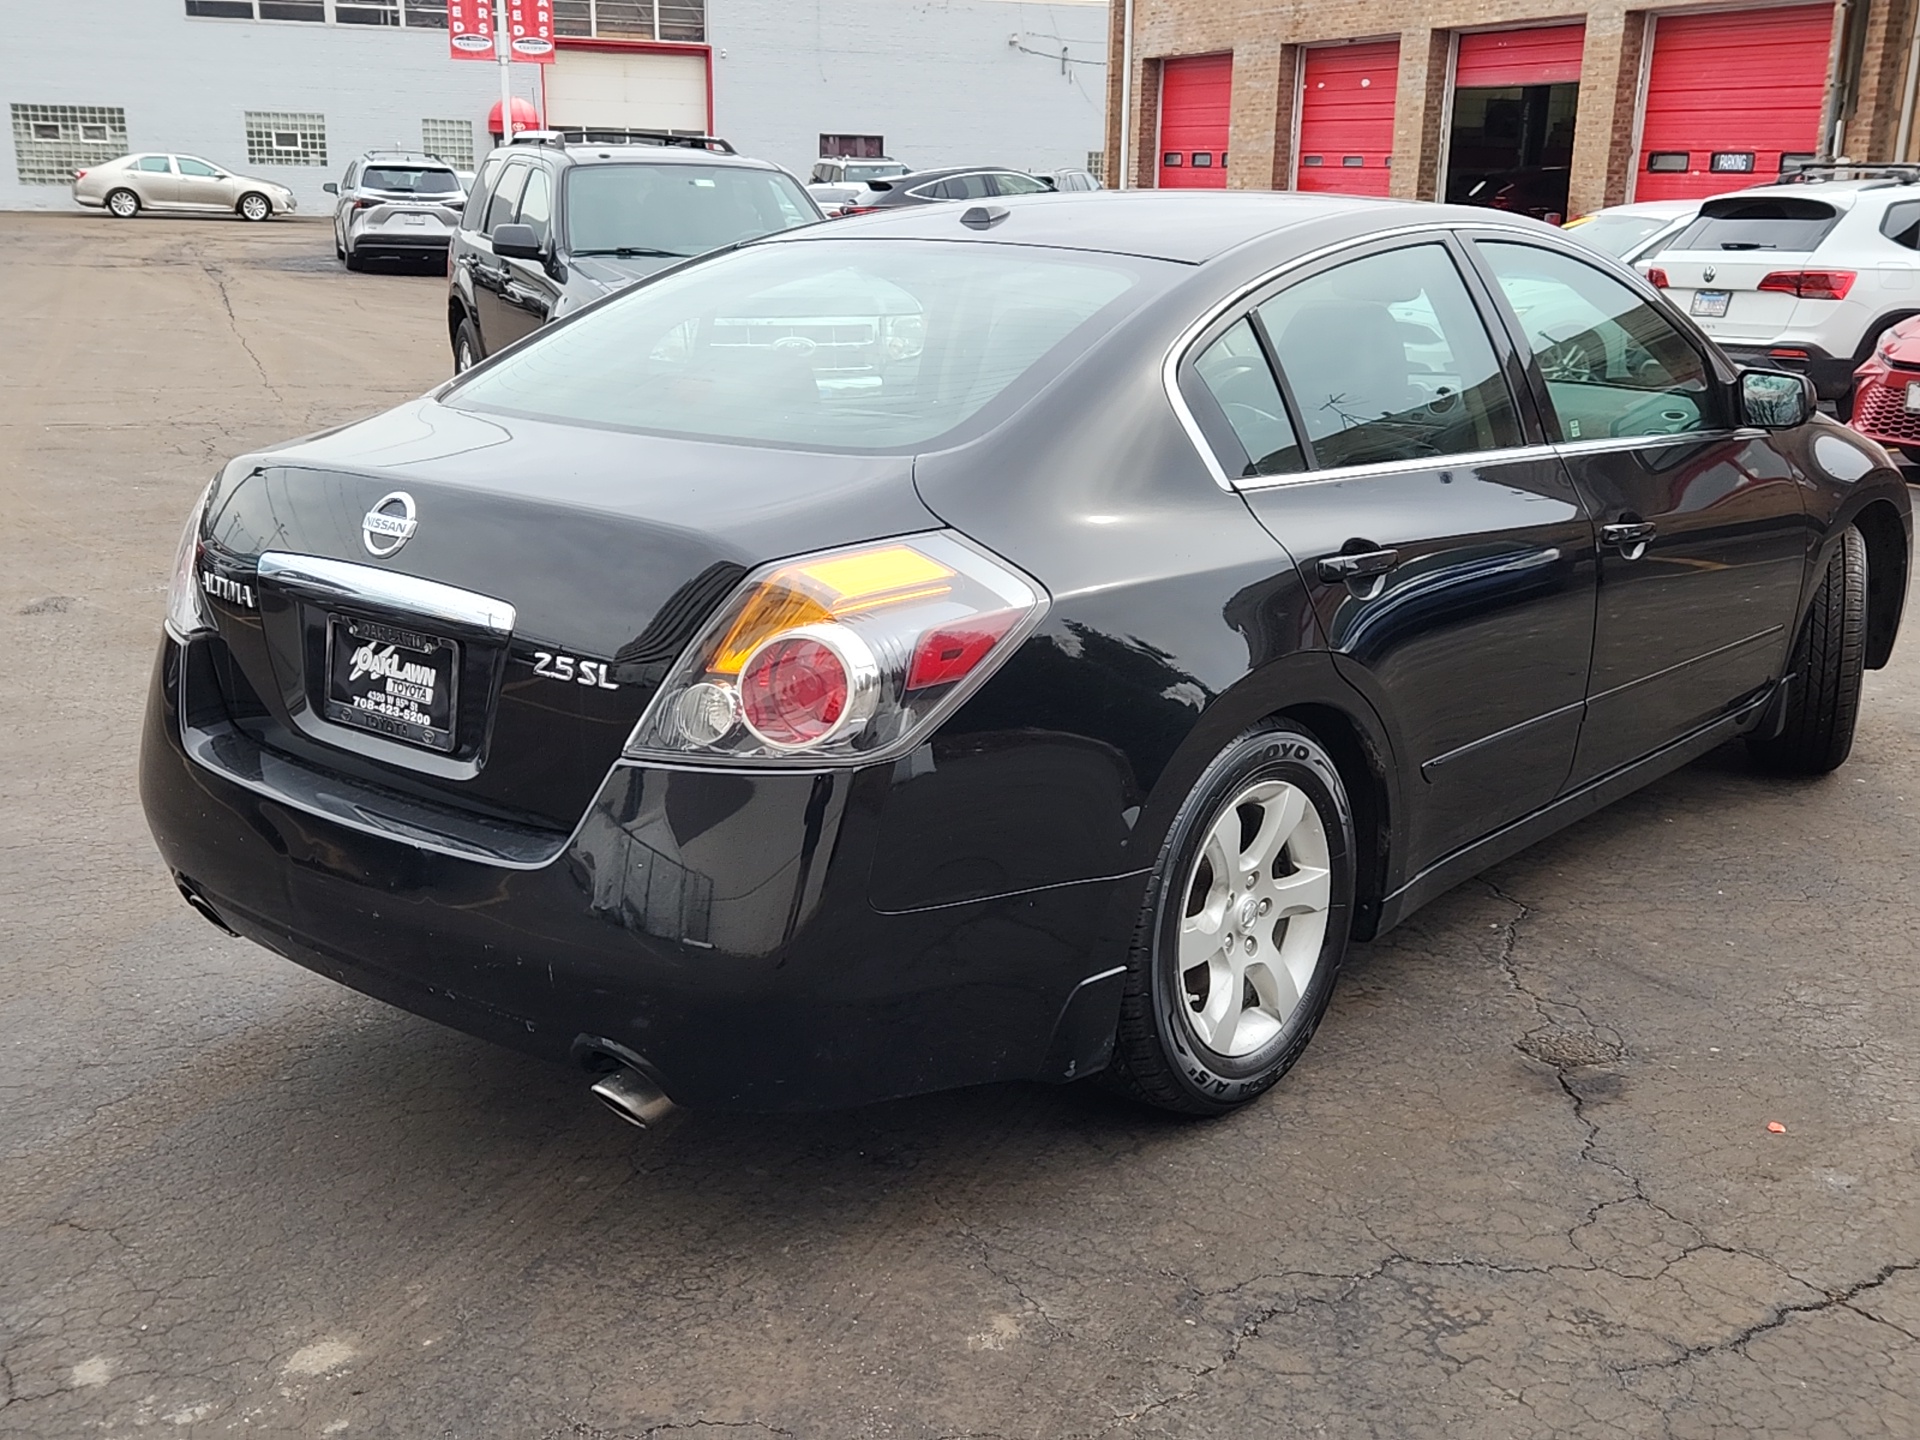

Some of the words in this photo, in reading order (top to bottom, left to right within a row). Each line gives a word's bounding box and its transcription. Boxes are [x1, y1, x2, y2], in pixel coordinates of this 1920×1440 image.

[1719, 154, 1747, 170] PARKING
[364, 516, 407, 533] NISSAN
[202, 571, 257, 608] ALTIMA
[577, 661, 620, 690] SL
[386, 694, 395, 705] W
[391, 680, 428, 701] TOYOTA
[353, 695, 431, 726] 708-423-5200
[364, 712, 408, 736] TOYOTA
